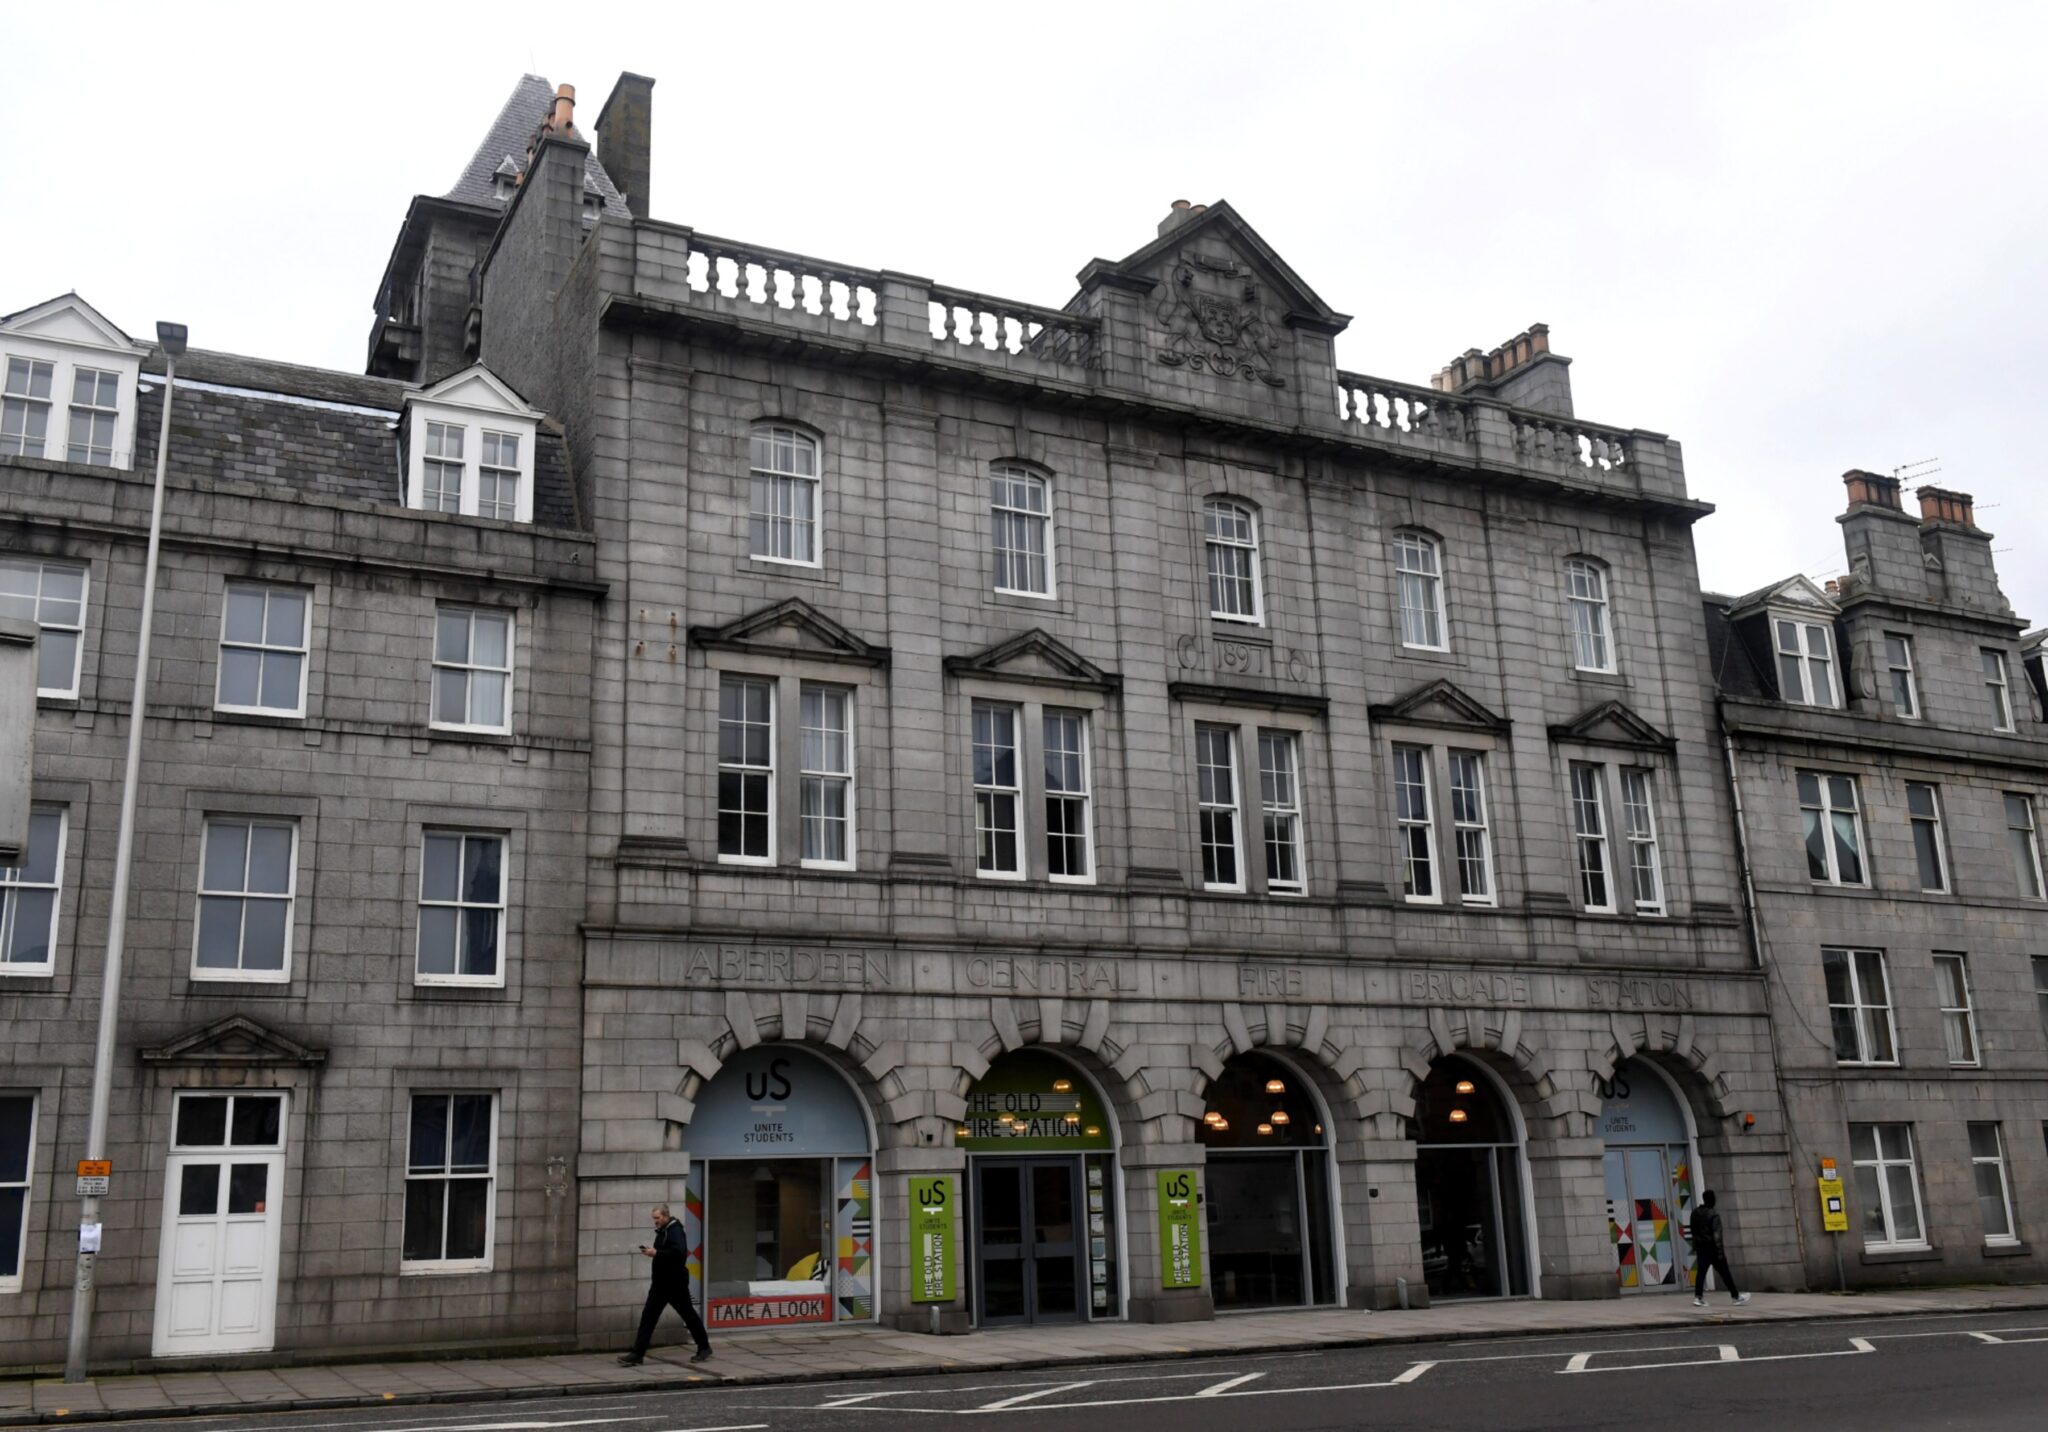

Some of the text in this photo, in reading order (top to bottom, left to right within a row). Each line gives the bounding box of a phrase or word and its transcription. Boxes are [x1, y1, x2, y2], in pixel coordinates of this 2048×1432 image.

[1217, 641, 1263, 673] 1897
[685, 947, 1693, 1009] ABERDEEN CENTRAL FIRE BRIGADE STATION
[1005, 1093, 1041, 1112] OLD
[744, 1133, 794, 1143] STUDENTS
[754, 1123, 783, 1132] UNITE
[1009, 1117, 1082, 1137] STATION
[933, 1232, 944, 1297] FIRE STATION
[923, 1255, 933, 1297] THE OLD
[713, 1299, 825, 1321] TAKE A LOOK!
